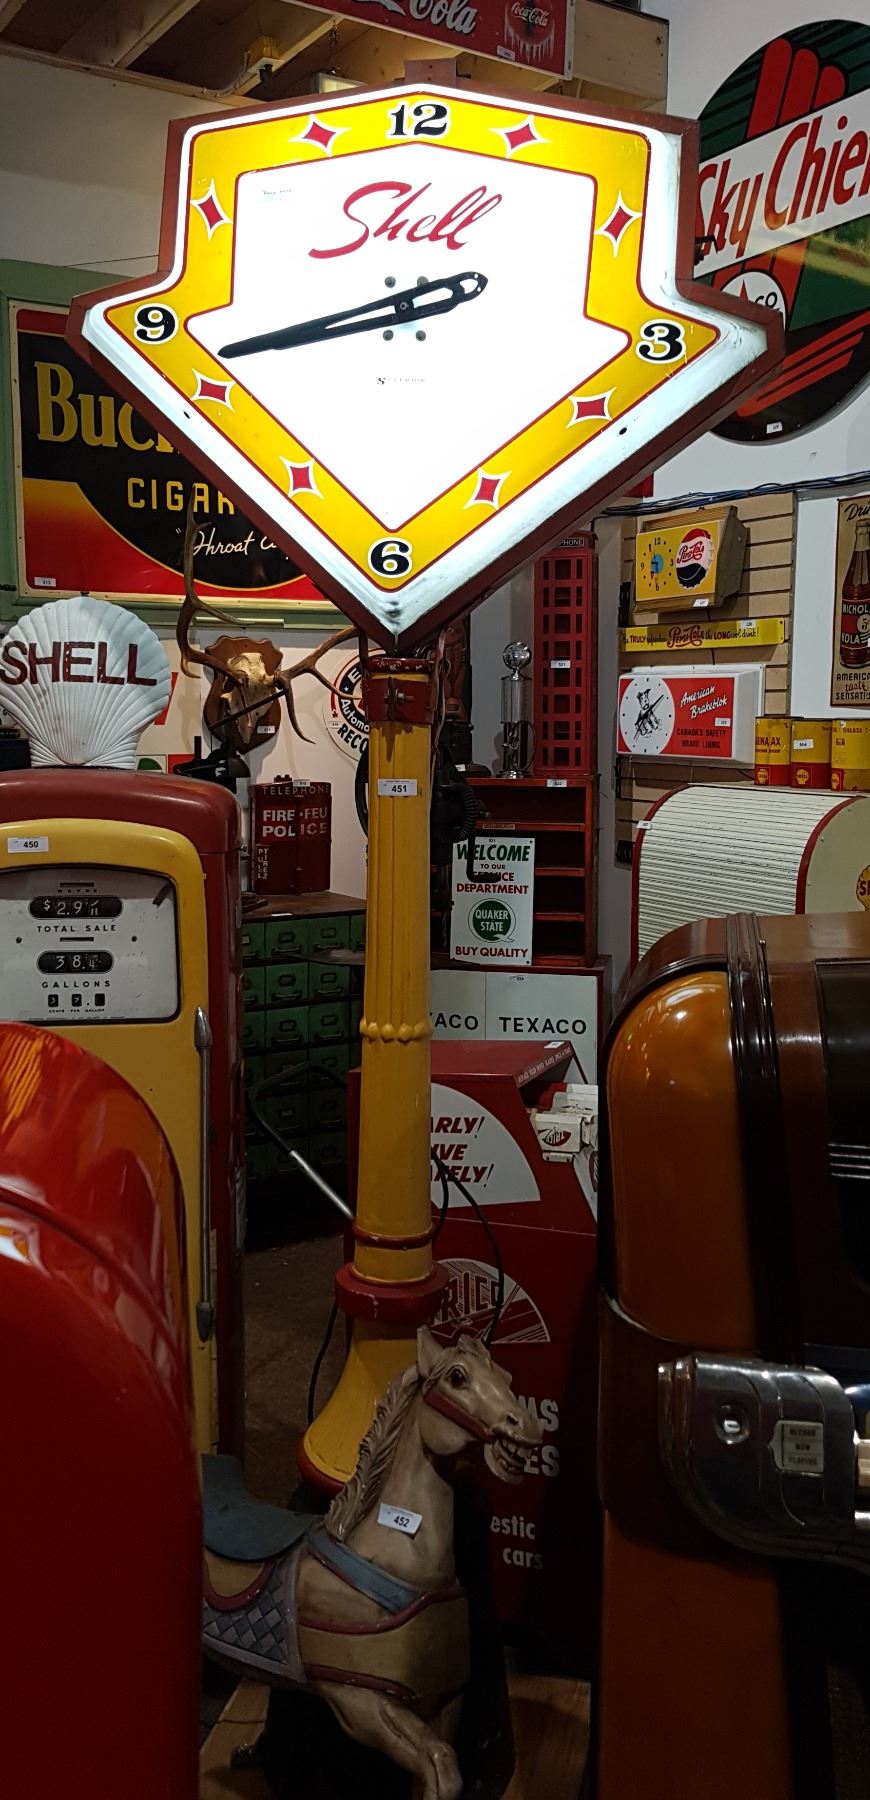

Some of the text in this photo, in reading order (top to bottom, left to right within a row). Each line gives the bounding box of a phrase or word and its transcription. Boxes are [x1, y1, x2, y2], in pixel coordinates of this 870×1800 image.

[390, 103, 448, 136] 12
[695, 159, 764, 259] Sky
[308, 180, 503, 260] Shell
[135, 306, 177, 342] 9
[638, 321, 683, 361] 3
[653, 537, 661, 545] 12
[369, 540, 410, 575] 6
[0, 640, 157, 686] SHELL
[681, 686, 715, 708] American
[690, 694, 728, 719] Brakeblok
[706, 729, 727, 737] SAFETY
[682, 740, 721, 749] BRAKE LINING
[262, 784, 330, 796] TELEPHONE
[391, 785, 407, 793] 451
[263, 809, 296, 822] FIRE
[23, 841, 39, 849] 450
[456, 883, 530, 895] DEPARTMENT
[474, 909, 509, 920] QUAKER
[37, 924, 117, 933] TOTAL SALE
[480, 921, 504, 932] STATE
[455, 946, 529, 958] BUY QUALITY
[42, 980, 111, 989] GALLONS
[430, 1012, 479, 1031] ACO
[499, 1016, 587, 1035] TEXACO
[393, 1516, 410, 1528] 452
[502, 1547, 544, 1571] cars
